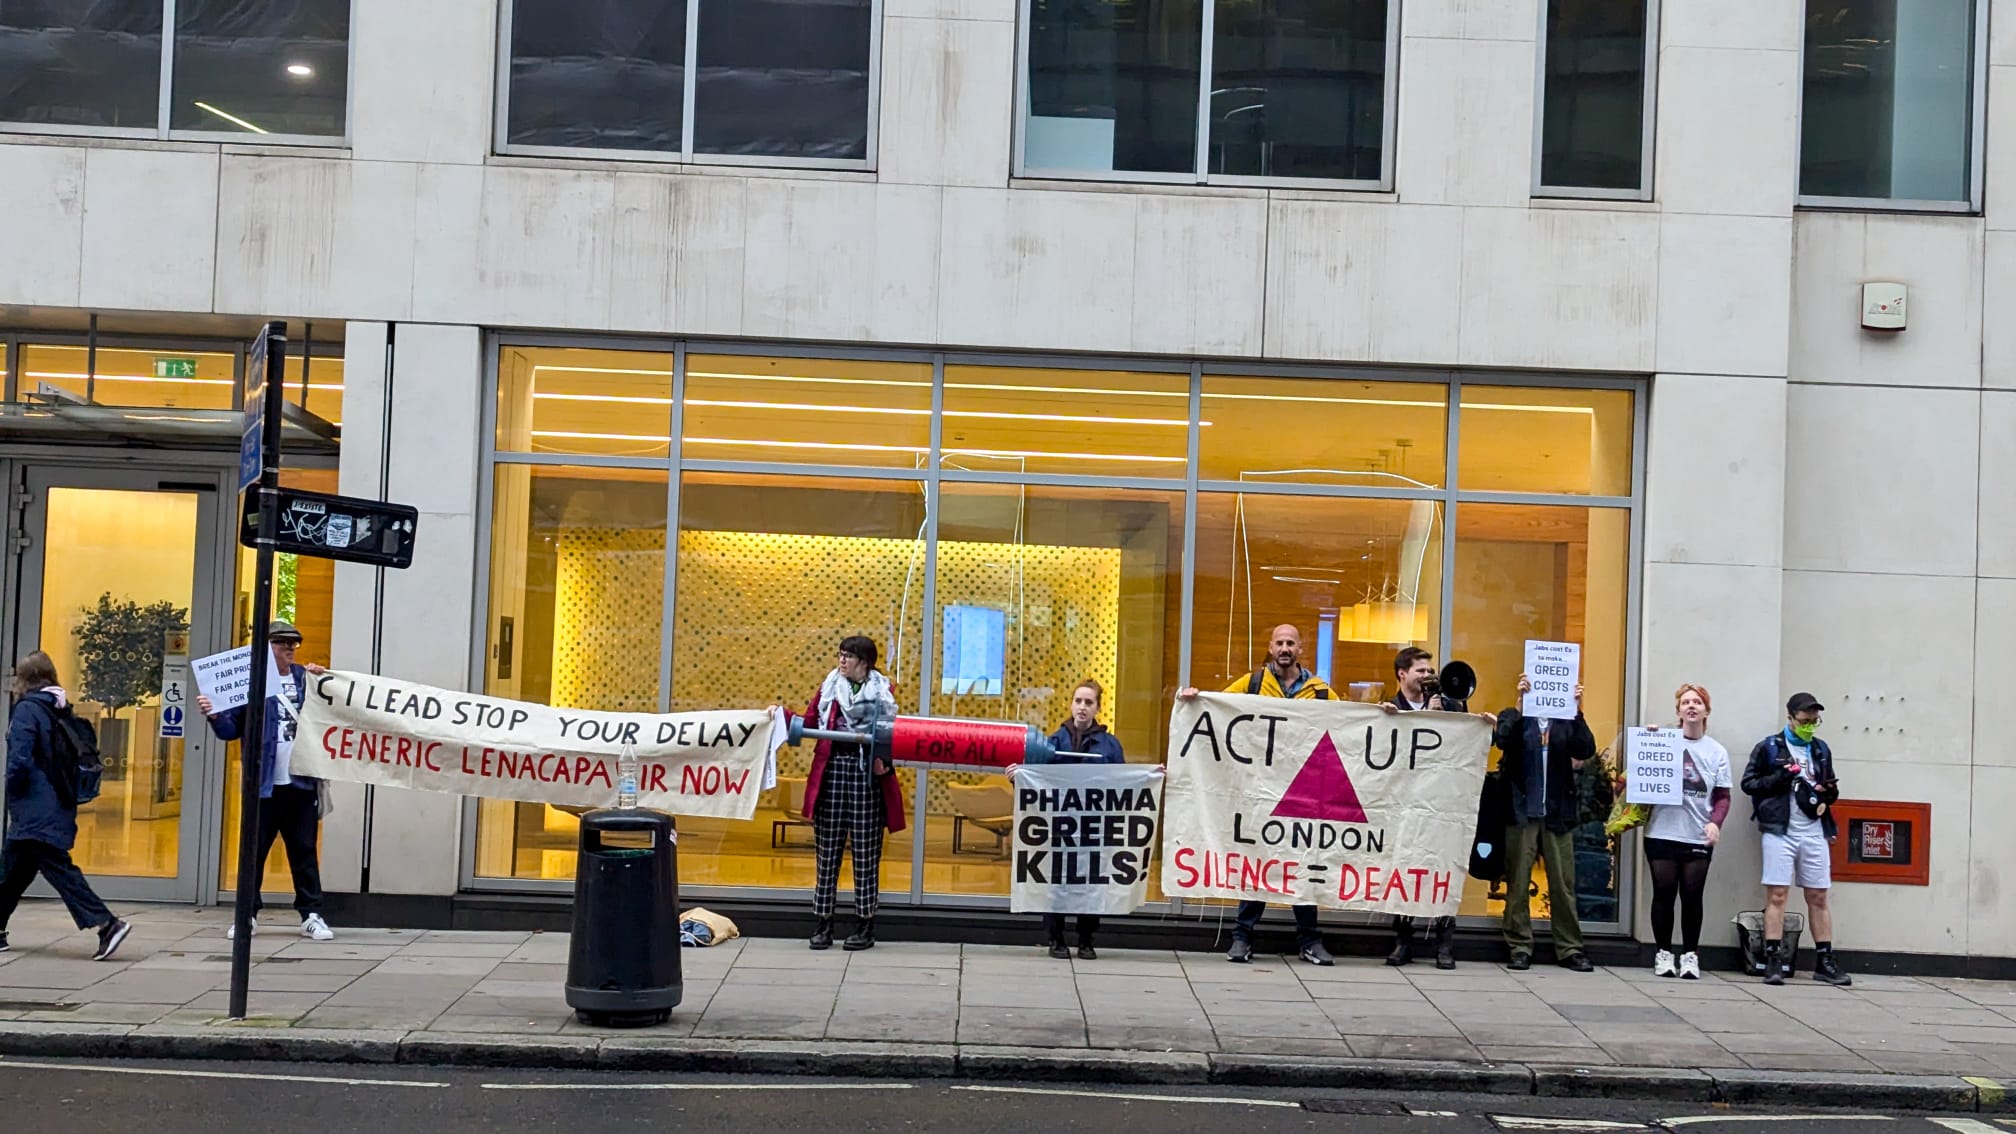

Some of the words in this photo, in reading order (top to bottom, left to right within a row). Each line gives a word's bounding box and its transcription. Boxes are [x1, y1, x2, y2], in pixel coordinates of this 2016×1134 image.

[198, 660, 219, 671] BREAK
[220, 657, 232, 665] THE
[1534, 664, 1570, 676] GREED
[215, 668, 233, 680] FAIR
[214, 683, 233, 694] FAIR
[1533, 680, 1569, 692] COSTS
[228, 693, 245, 704] FOR
[1535, 696, 1566, 708] LIVES
[316, 676, 442, 719] GILEAD
[452, 701, 528, 731] STOP
[558, 717, 640, 744] YOUR
[656, 721, 757, 748] DELAY
[1180, 711, 1288, 767] ACT
[1365, 725, 1443, 770] UP
[915, 738, 956, 759] FOR
[964, 741, 999, 762] ALL
[322, 726, 442, 772] GENERIC
[680, 764, 750, 795] NOW
[1638, 751, 1674, 762] GREED
[1637, 766, 1674, 778] COSTS
[1639, 782, 1671, 793] LIVES
[1019, 788, 1156, 812] PHARMA
[1018, 815, 1155, 847] GREED
[1233, 812, 1384, 853] LONDON
[1864, 825, 1878, 837] Dry
[1864, 834, 1884, 845] Riser
[1016, 847, 1151, 885] KILLS!
[1174, 847, 1299, 895] SILENCE
[1338, 863, 1451, 904] DEATH
